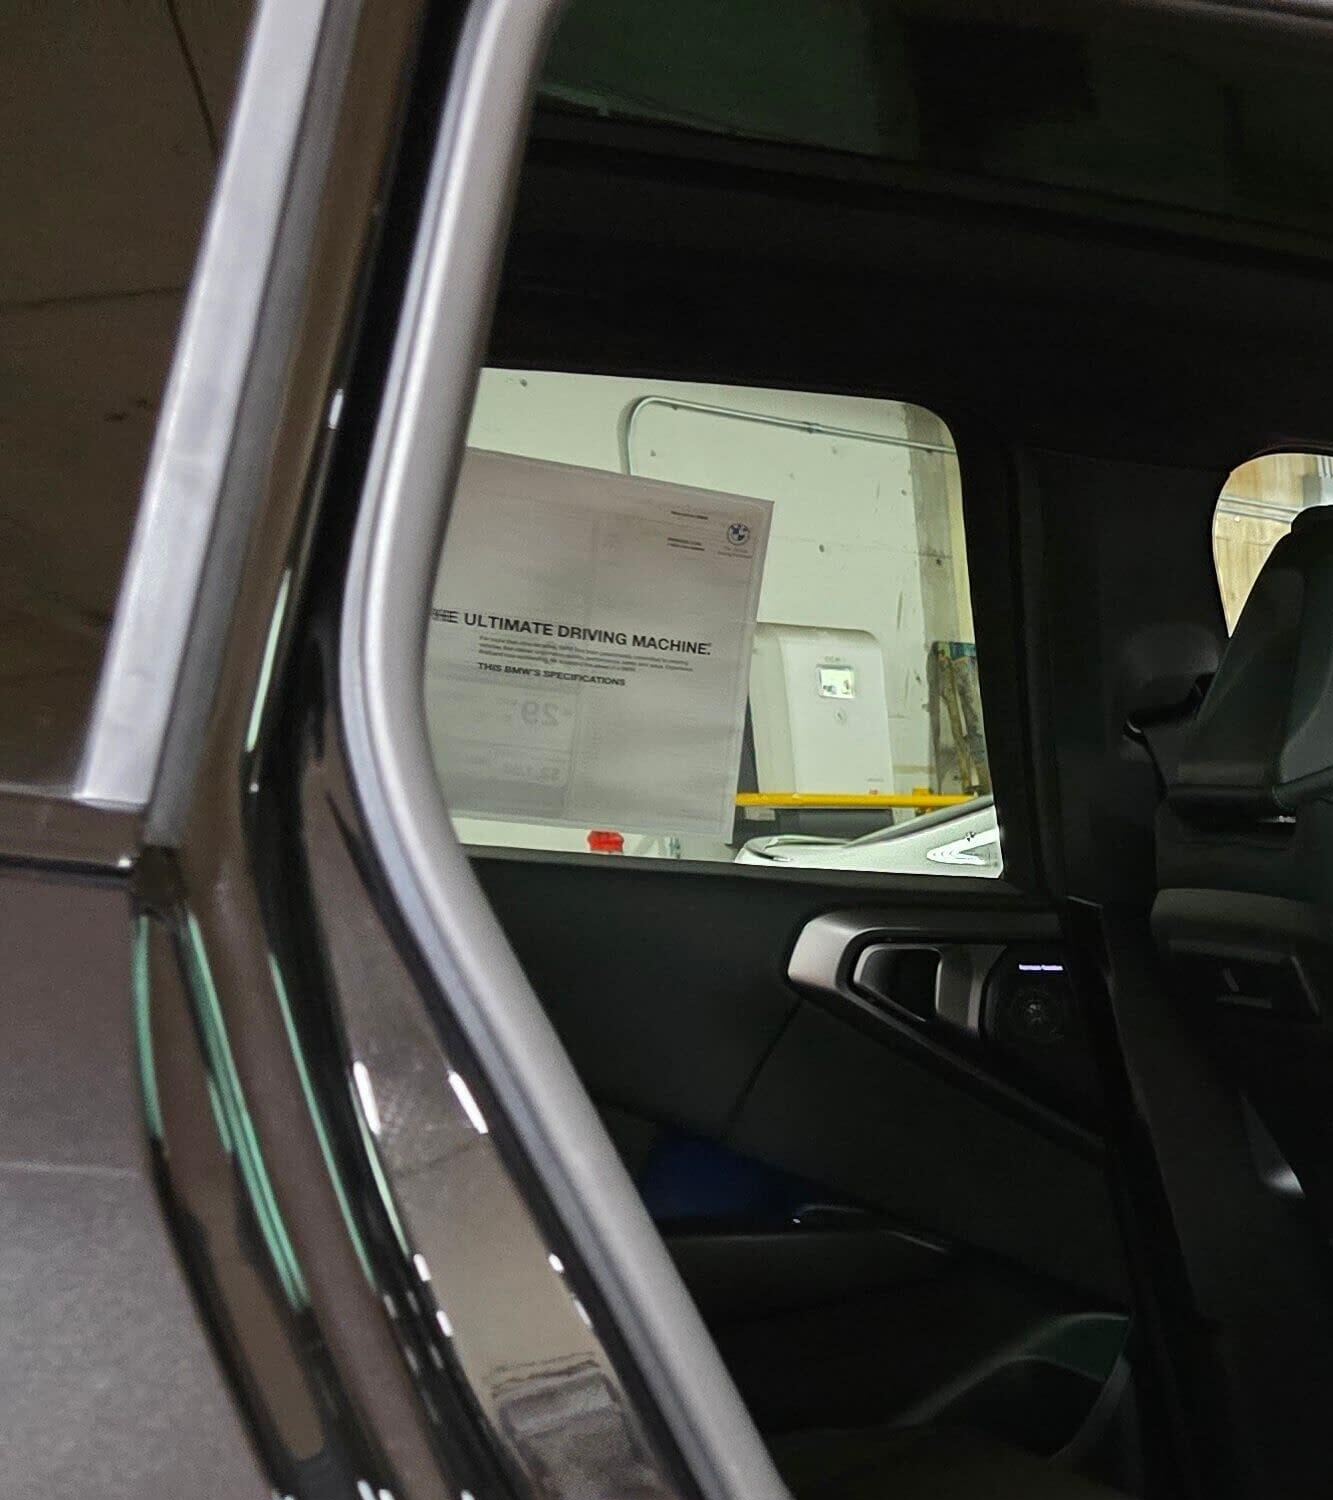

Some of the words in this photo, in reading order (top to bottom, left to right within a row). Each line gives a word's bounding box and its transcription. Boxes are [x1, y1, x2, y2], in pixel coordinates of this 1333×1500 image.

[464, 612, 554, 636] ULTIMATE
[557, 625, 628, 646] DRIVING
[478, 662, 502, 673] THIS
[543, 670, 626, 686] SPECIFICATIONS
